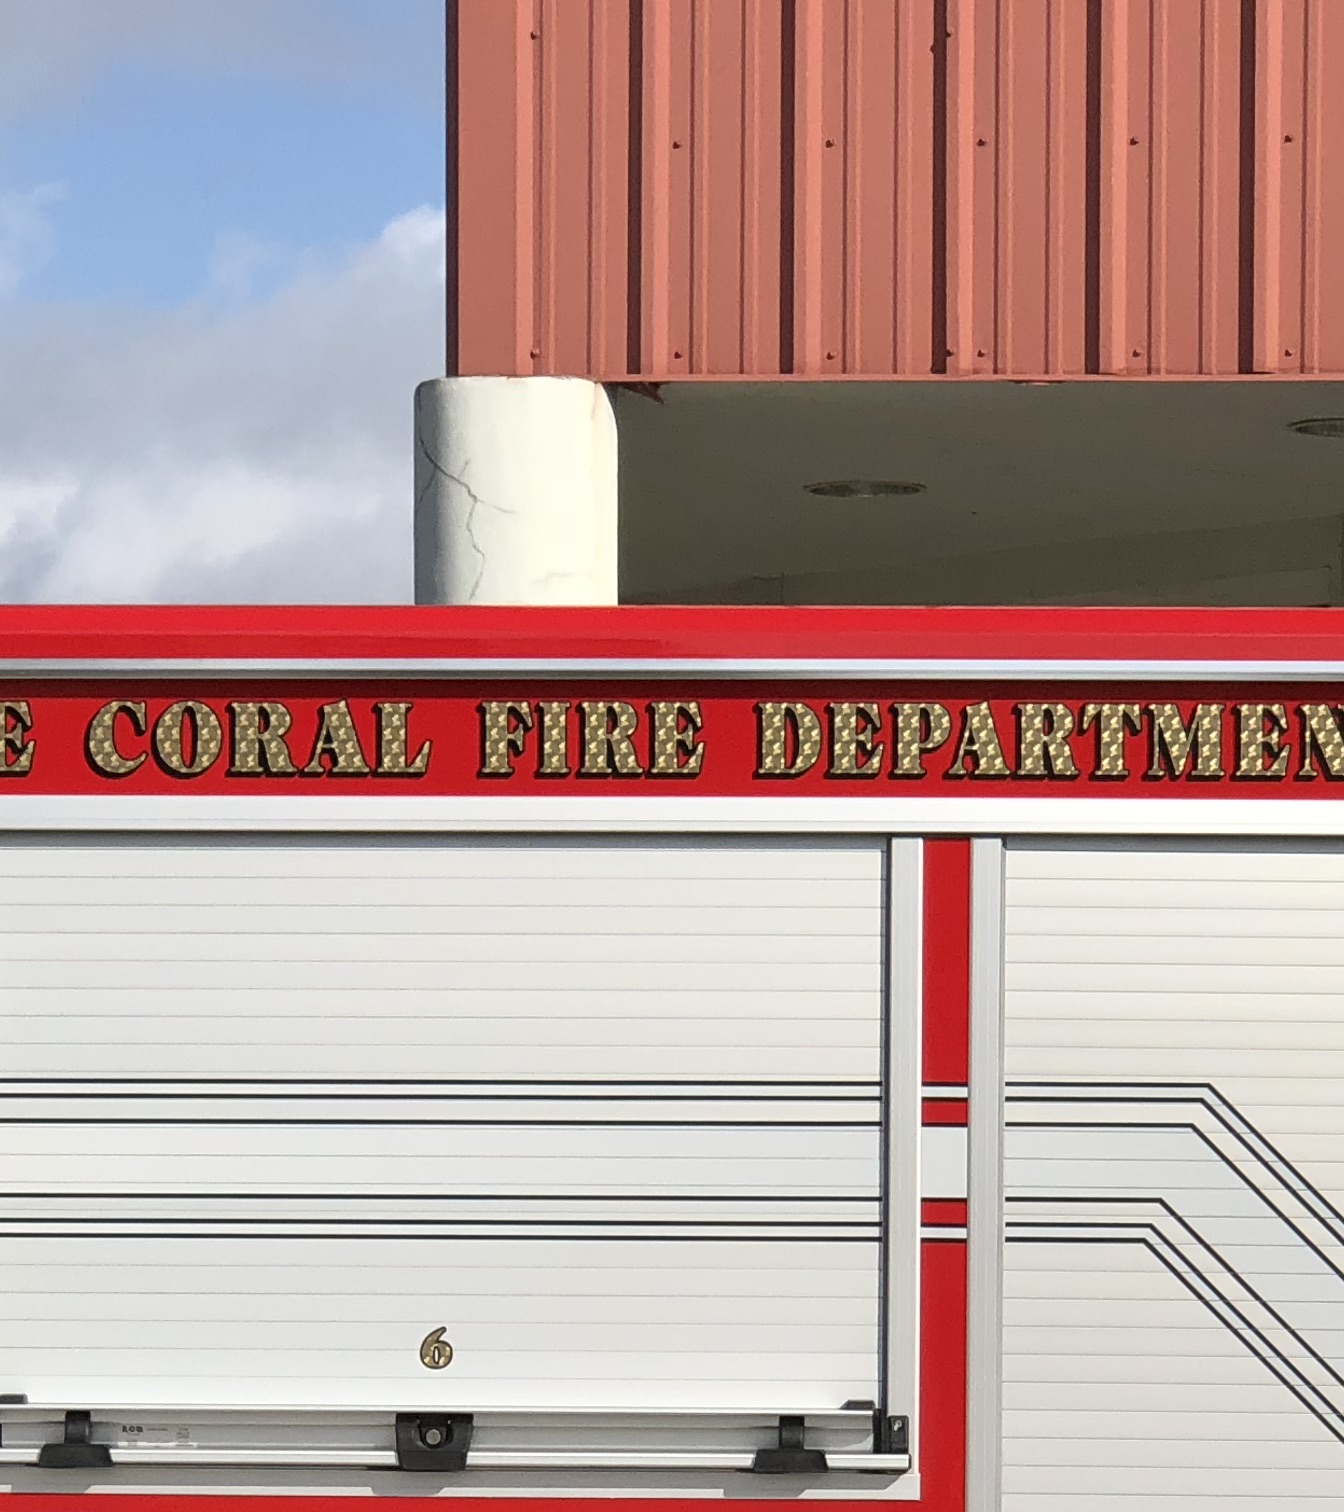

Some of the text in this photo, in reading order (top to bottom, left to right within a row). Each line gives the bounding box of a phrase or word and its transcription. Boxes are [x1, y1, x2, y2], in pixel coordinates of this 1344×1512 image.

[82, 698, 434, 779] CORAL
[474, 699, 707, 780] FIRE
[420, 1326, 453, 1370] 6
